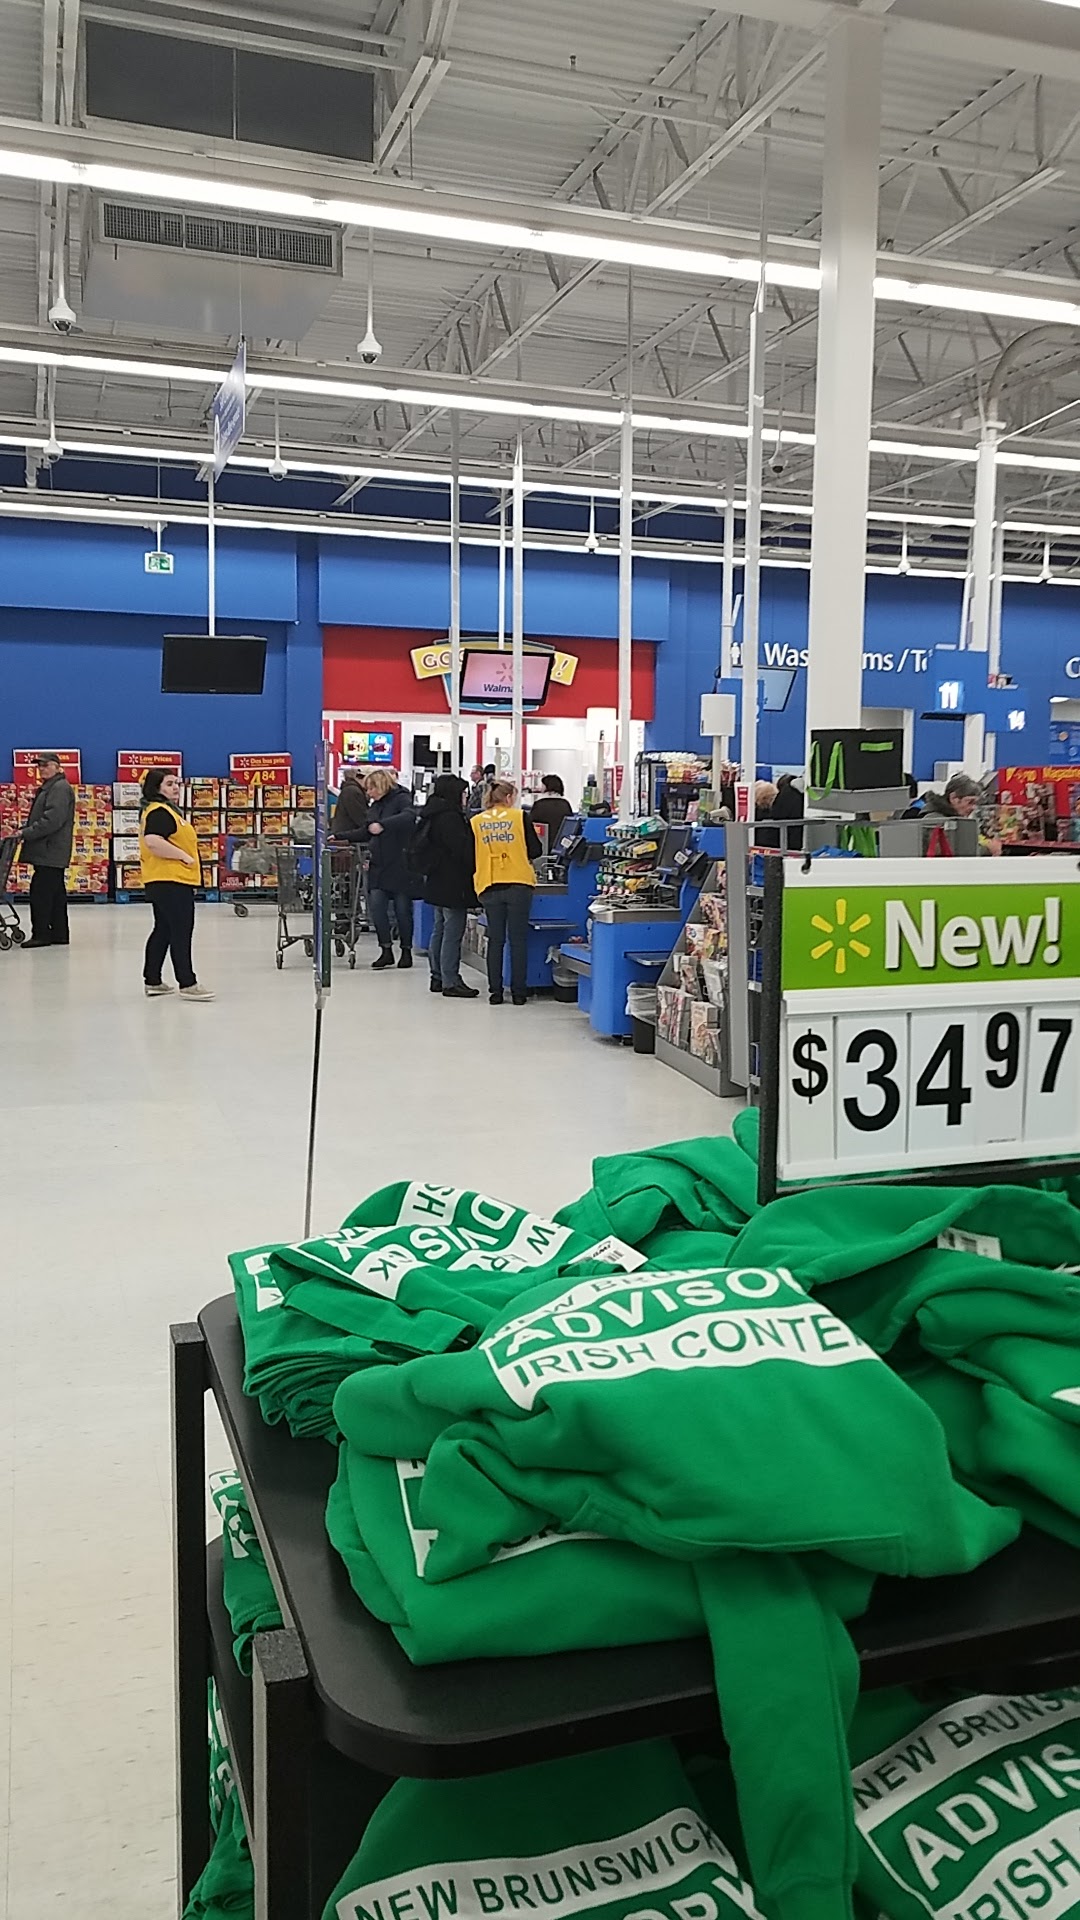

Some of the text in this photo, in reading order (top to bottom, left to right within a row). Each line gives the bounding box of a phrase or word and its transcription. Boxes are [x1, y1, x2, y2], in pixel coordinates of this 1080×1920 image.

[938, 681, 959, 709] 11
[479, 820, 513, 832] Happy
[490, 830, 515, 843] Help
[884, 896, 1061, 970] New!
[513, 1341, 655, 1388] IRISH
[853, 1691, 1064, 1811] NEW BRUNS
[354, 1879, 457, 1920] NEW
